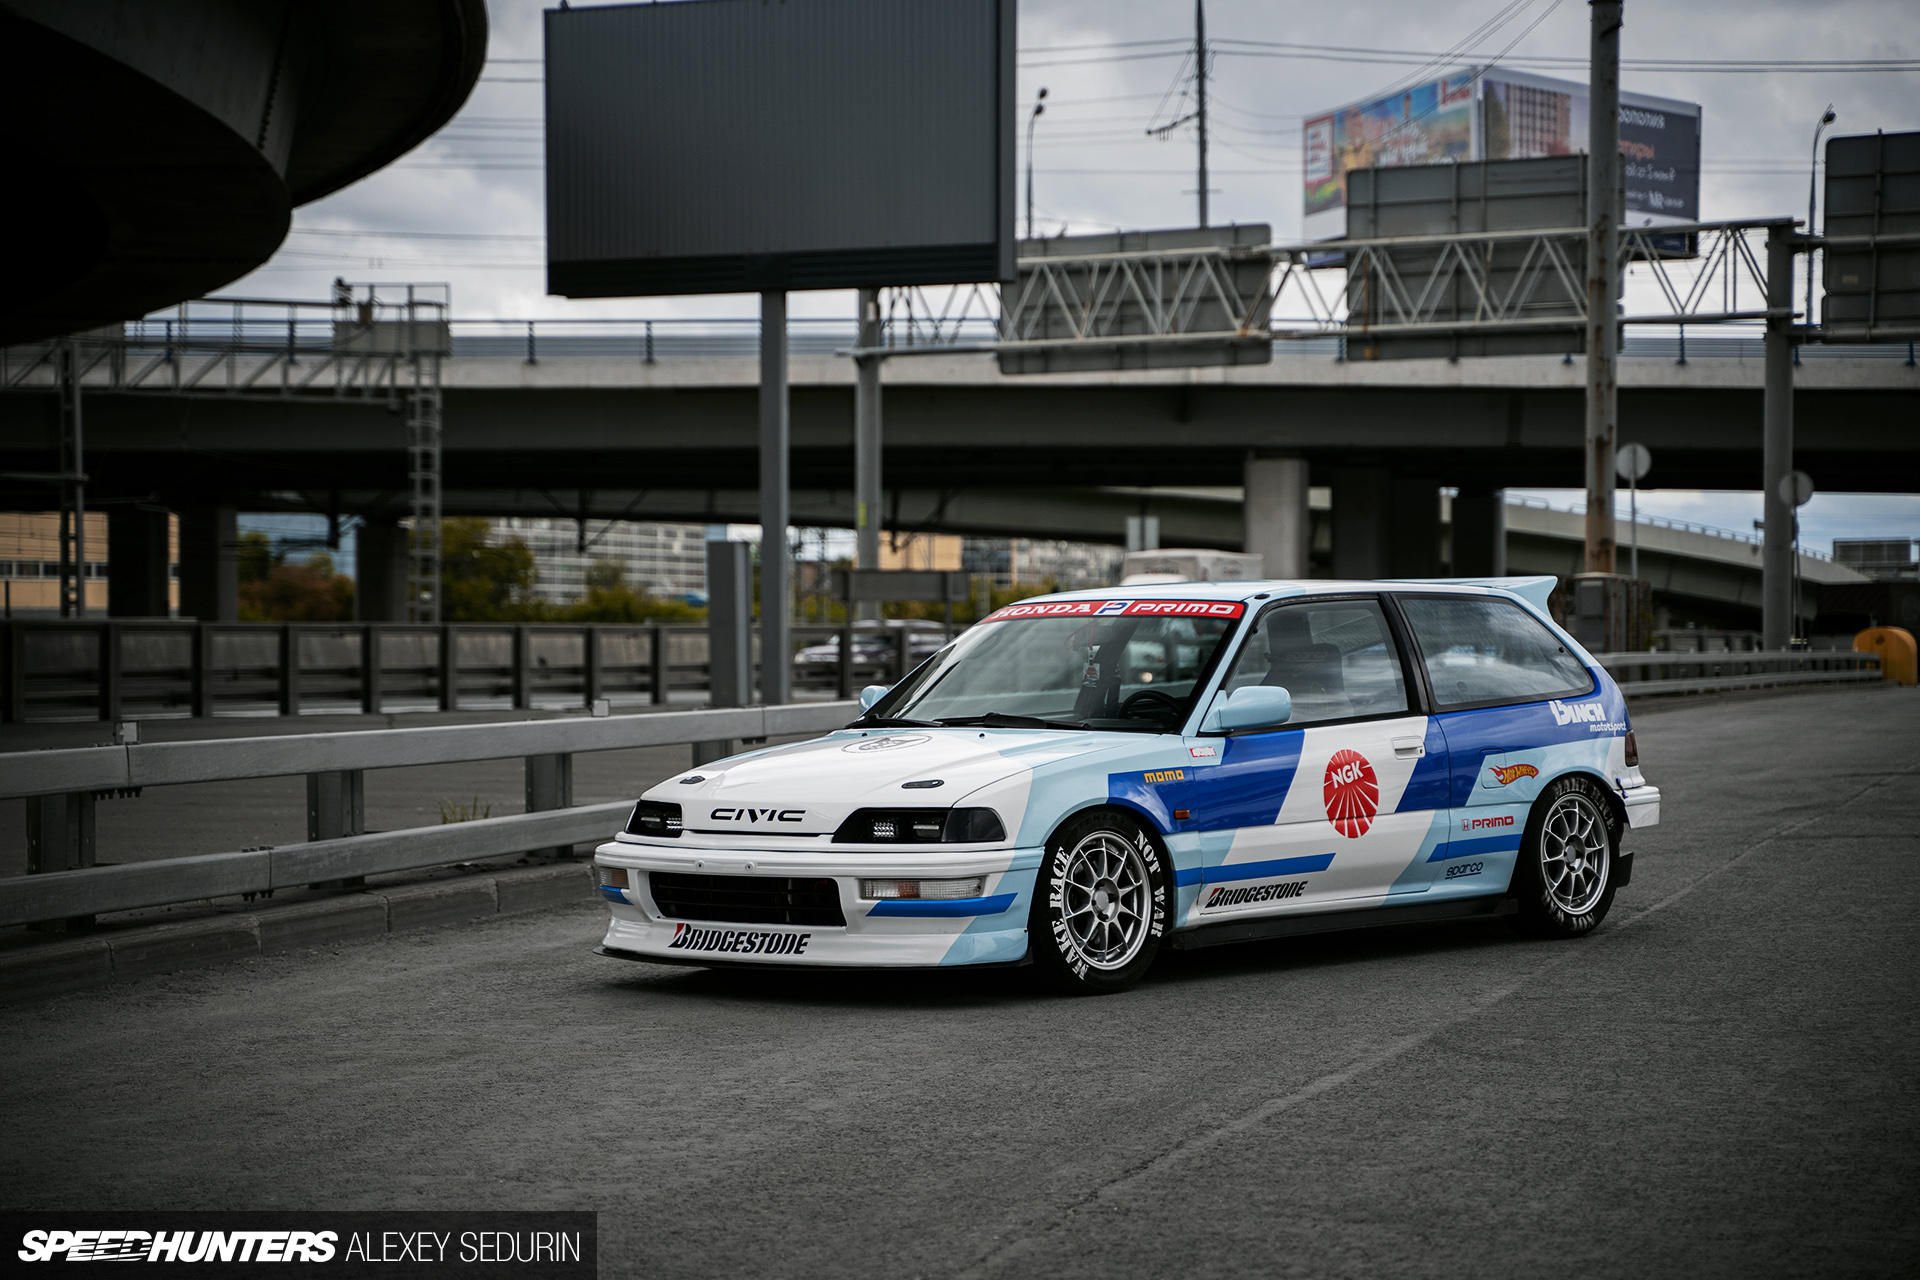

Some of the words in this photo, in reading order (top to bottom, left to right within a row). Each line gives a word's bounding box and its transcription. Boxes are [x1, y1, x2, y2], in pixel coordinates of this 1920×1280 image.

[991, 603, 1092, 619] HONDA
[1131, 603, 1235, 614] PRIMO
[1589, 721, 1627, 736] motorsport
[1331, 760, 1364, 789] NGK
[710, 808, 806, 823] CIVIC
[1553, 777, 1588, 799] MAKE
[1590, 785, 1615, 830] RACE
[1472, 815, 1514, 829] PRIMO
[1050, 846, 1070, 908] RACE
[1134, 830, 1161, 874] NOT
[1151, 885, 1166, 937] WAR
[1445, 861, 1484, 880] sparco
[1205, 881, 1309, 909] BRIDGESTONE
[668, 923, 812, 955] BRIDGESTONE
[1052, 918, 1089, 980] MAKE
